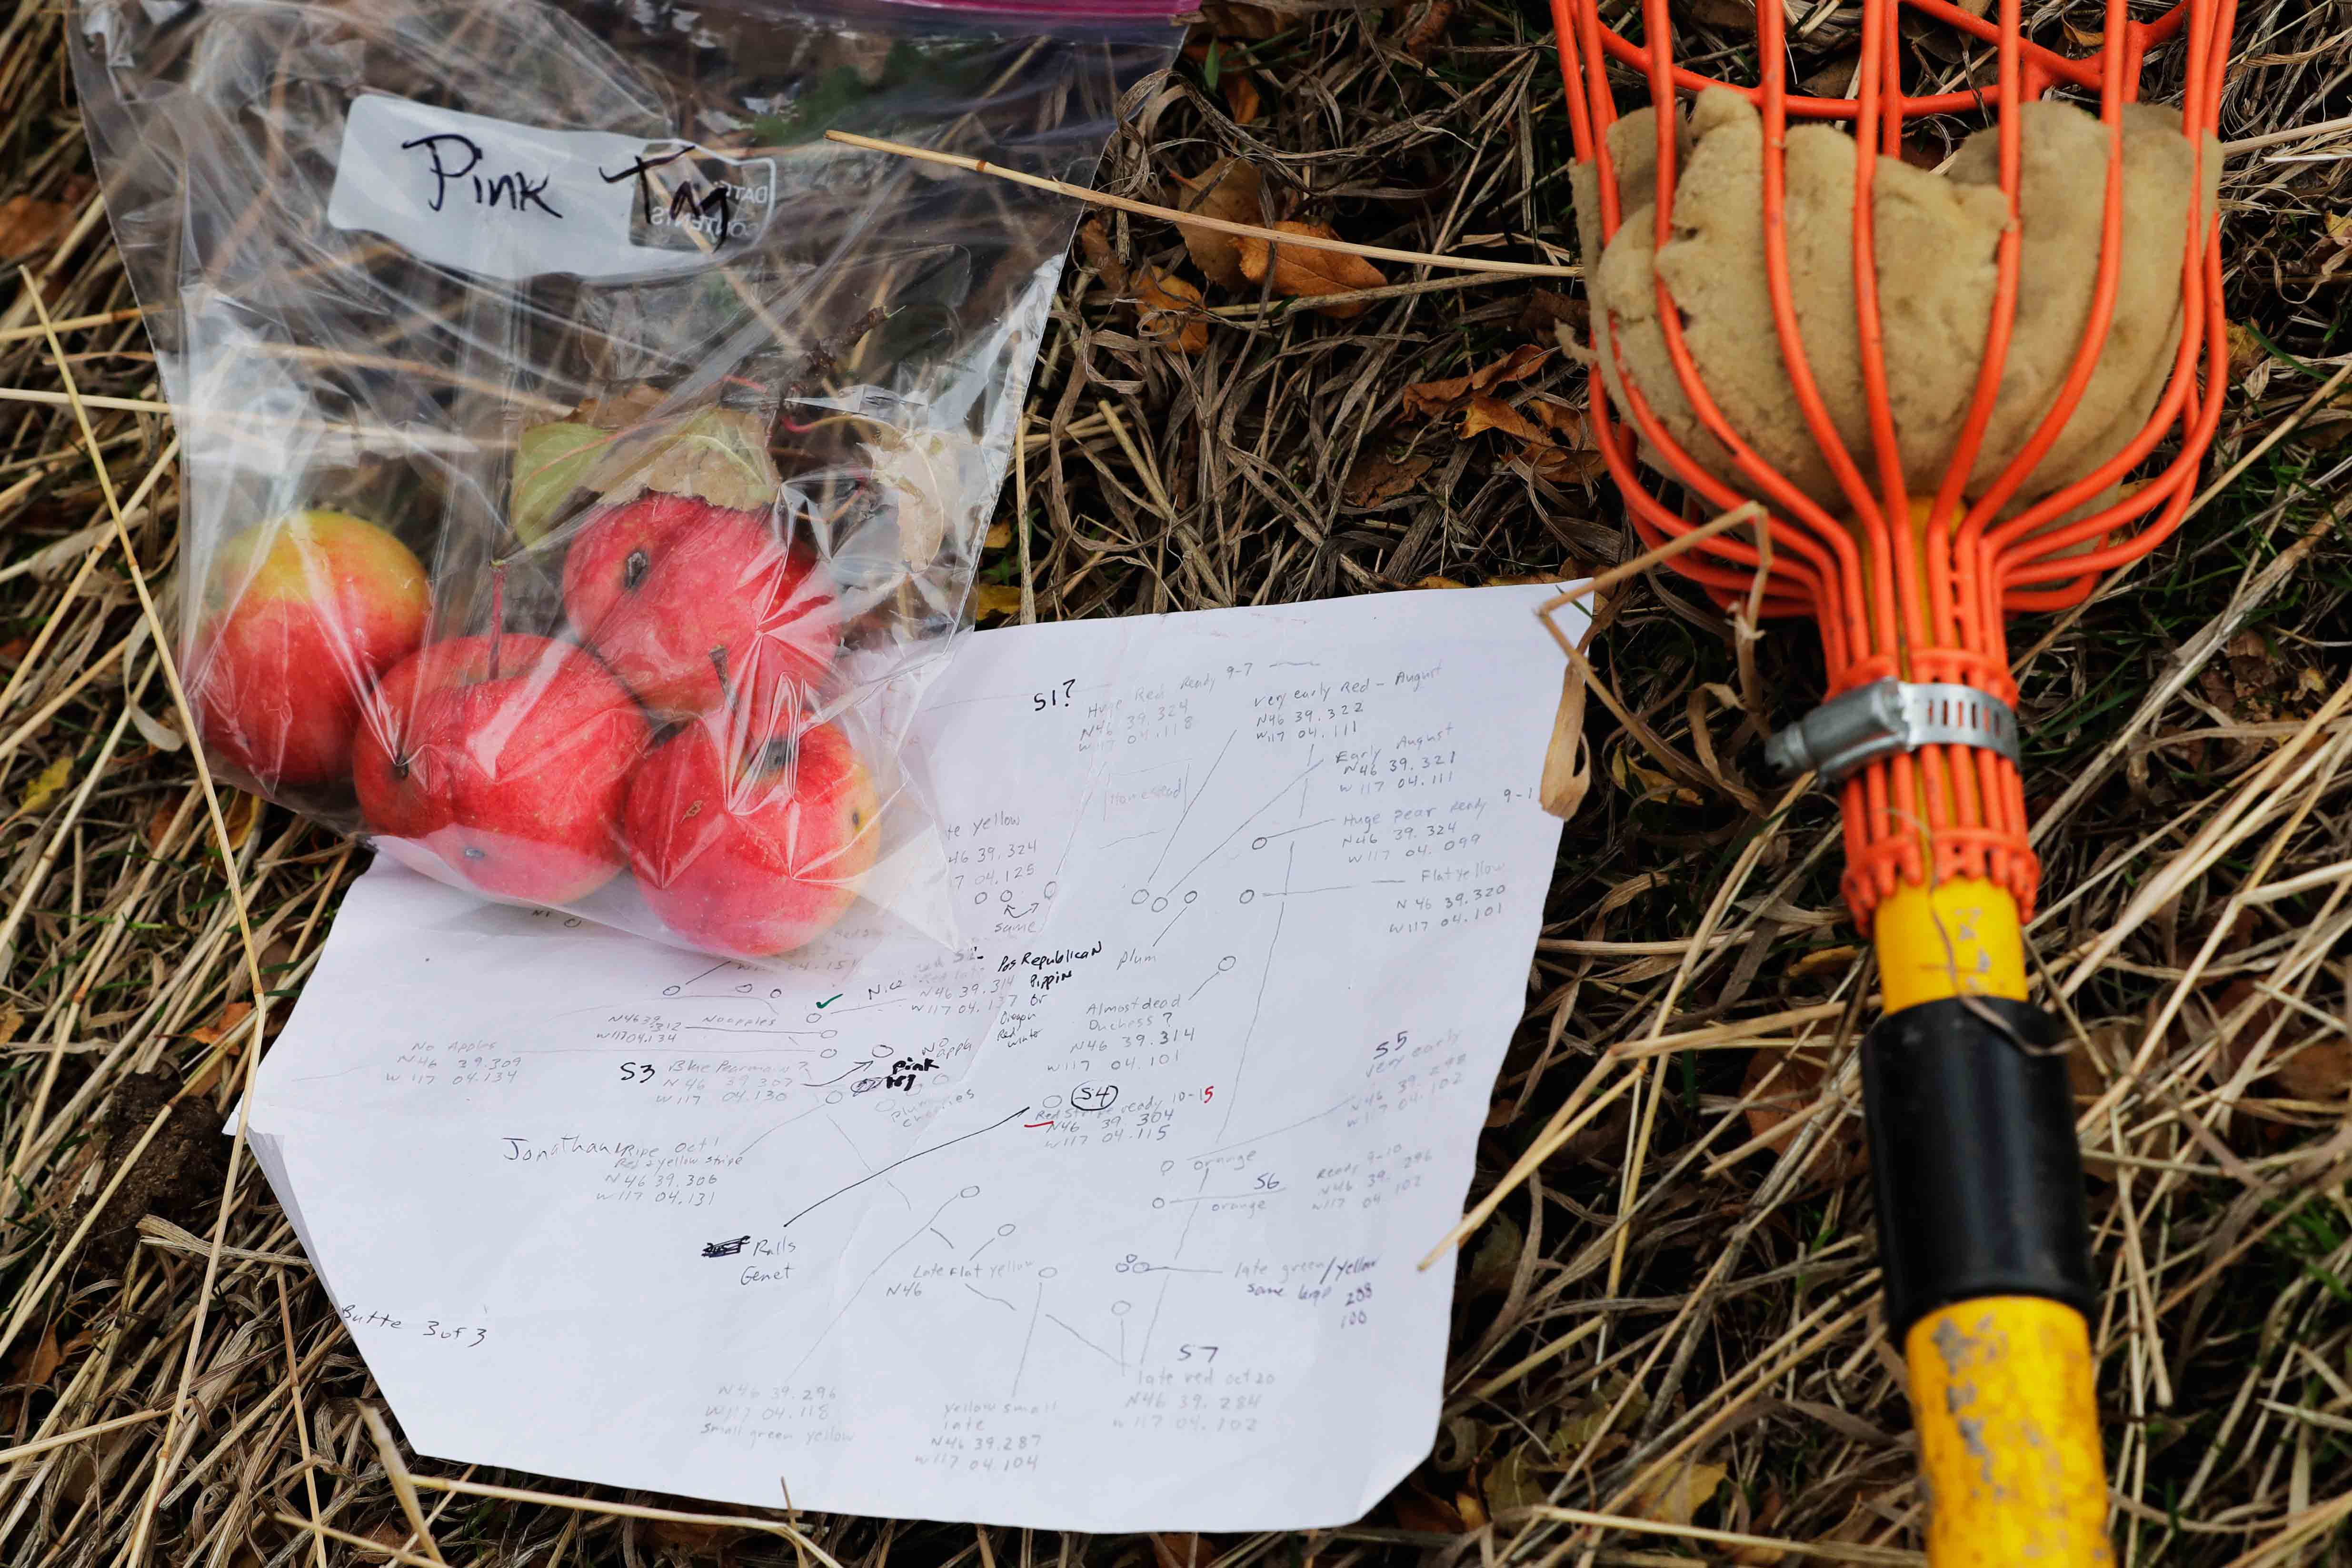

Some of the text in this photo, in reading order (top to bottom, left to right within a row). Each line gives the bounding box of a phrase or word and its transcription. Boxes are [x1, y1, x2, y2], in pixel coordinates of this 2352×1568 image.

[402, 133, 729, 253] Pink Tag
[1294, 682, 1331, 702] early
[1340, 678, 1370, 693] Red
[1256, 713, 1284, 727] N46
[1336, 721, 1454, 764] Early August
[946, 811, 1021, 840] te yellow
[1344, 814, 1381, 834] Huge
[1342, 834, 1377, 848] N46
[947, 850, 968, 864] 46
[1421, 867, 1452, 882] Flat
[994, 922, 1037, 934] same
[919, 987, 952, 1000] N46
[1086, 993, 1181, 1015] Almost dead
[412, 1041, 434, 1052] No
[1070, 1040, 1107, 1053] N46
[1373, 1030, 1408, 1060] S5
[620, 1062, 656, 1084] S3
[1254, 1172, 1280, 1190] S6
[740, 1262, 795, 1285] Genet
[886, 1281, 922, 1298] N46
[342, 1304, 404, 1329] Butte
[422, 1320, 440, 1336] 3
[467, 1328, 488, 1348] 3
